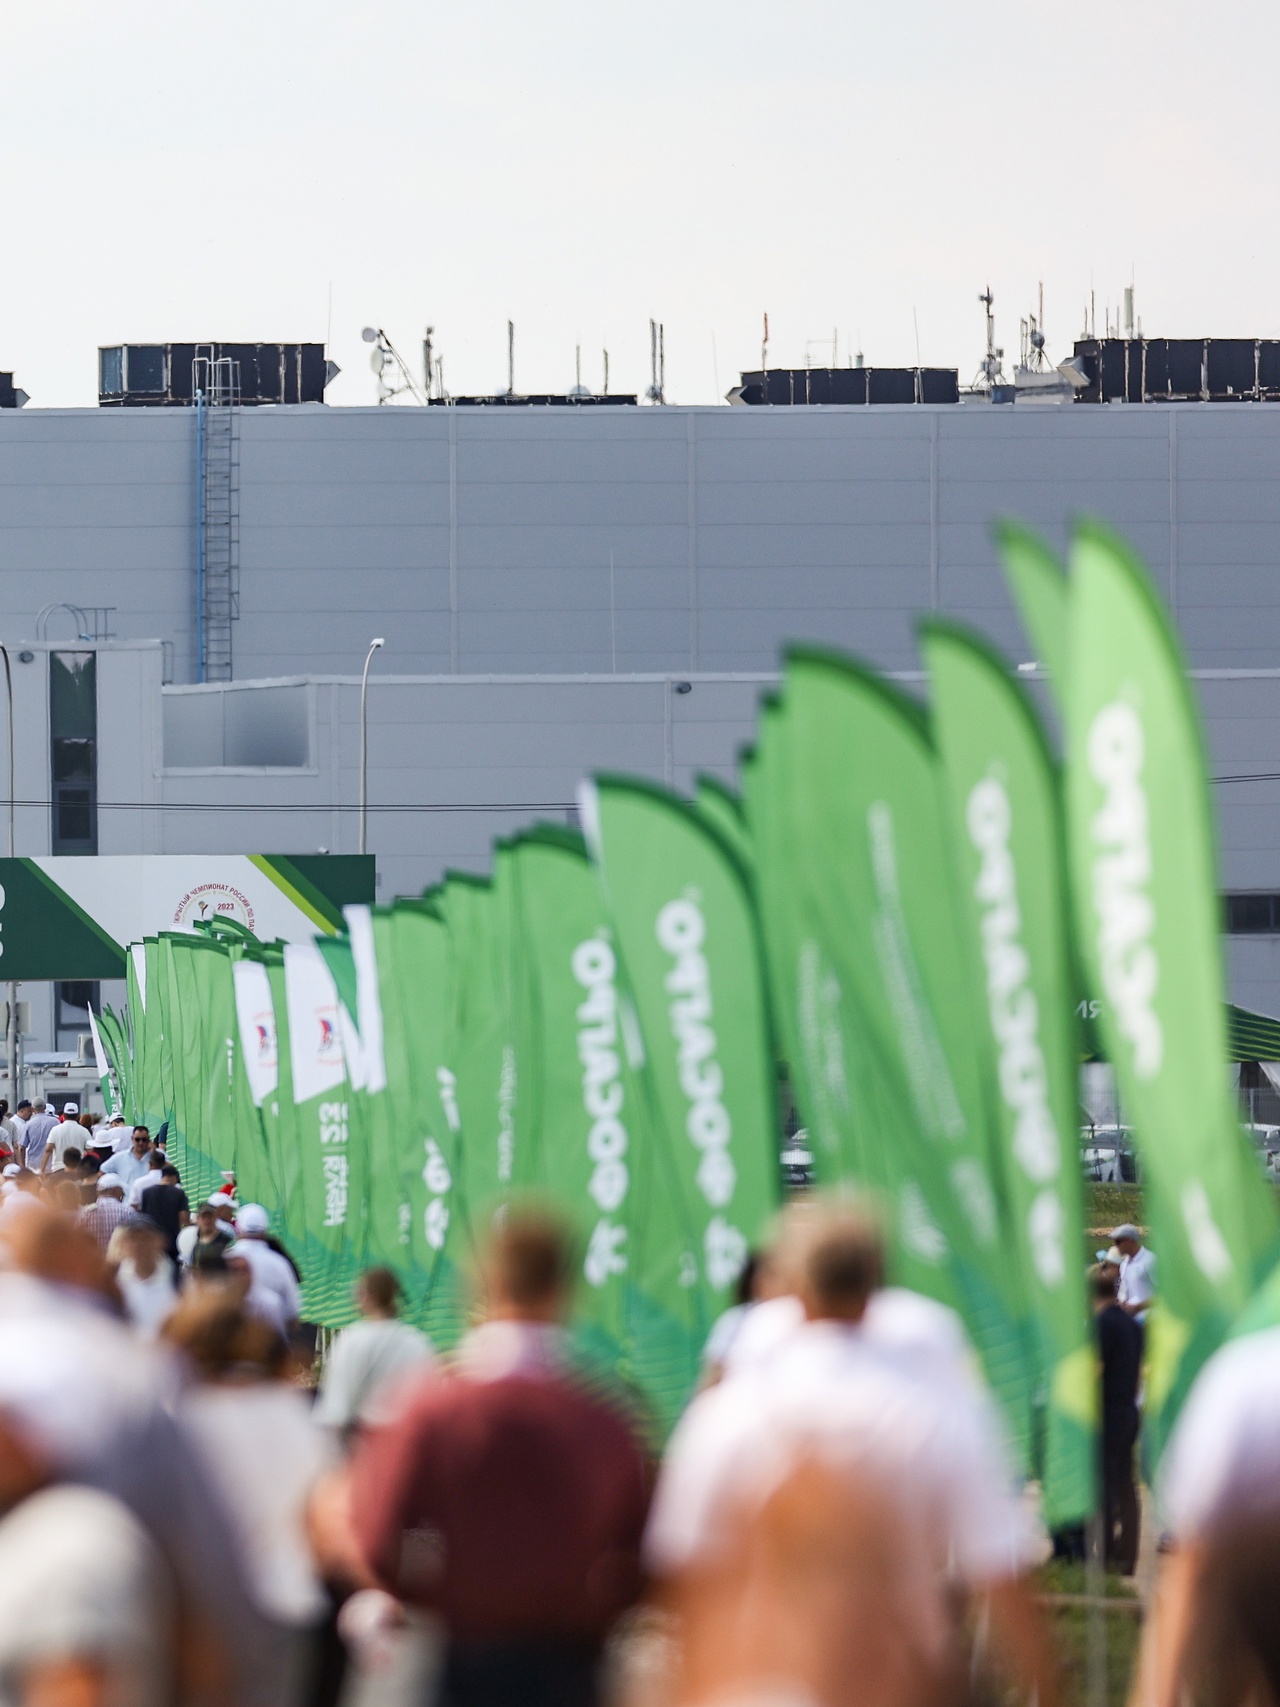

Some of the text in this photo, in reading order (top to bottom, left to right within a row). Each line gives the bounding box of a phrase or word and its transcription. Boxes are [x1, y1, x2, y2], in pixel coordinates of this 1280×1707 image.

[173, 893, 191, 924] КРЫТЫЙ
[190, 883, 229, 896] ЧЕМПИОНАТ
[229, 887, 251, 909] РОССИИ
[217, 902, 235, 911] 2023
